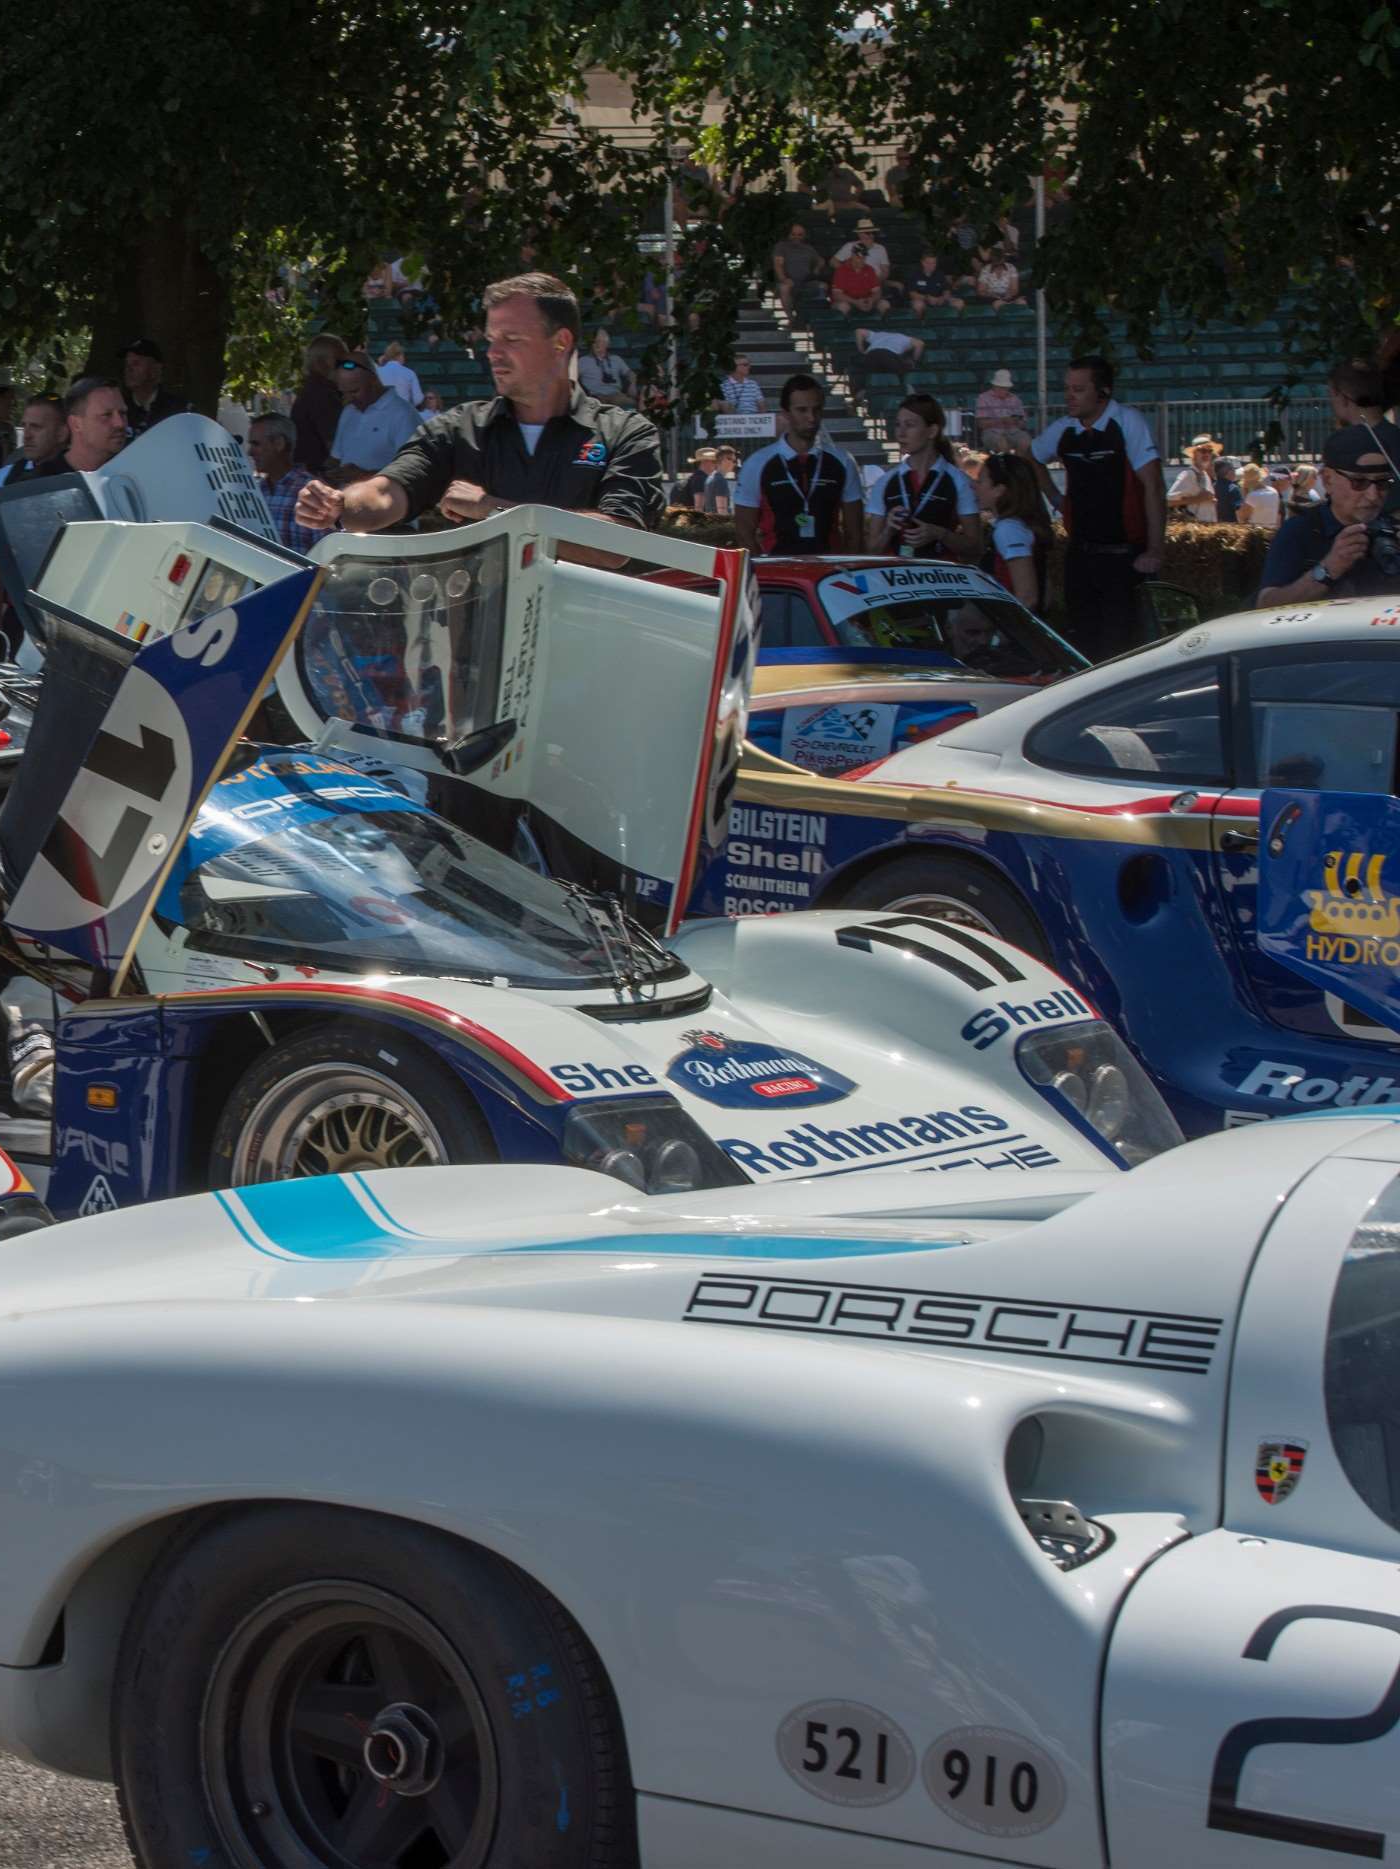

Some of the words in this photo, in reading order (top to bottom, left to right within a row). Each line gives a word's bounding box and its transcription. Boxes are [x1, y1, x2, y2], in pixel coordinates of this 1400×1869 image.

[881, 569, 969, 587] Valvoline
[863, 589, 1012, 607] PORSCHE
[728, 806, 828, 845] BILSTEIN
[726, 841, 822, 875] Shell
[961, 989, 1090, 1051] Shell
[549, 1062, 659, 1092] She
[684, 1056, 819, 1088] Rothmans
[759, 1080, 810, 1095] RACING
[717, 1104, 1010, 1175] Rothmans
[686, 1277, 1222, 1366] PORSCHE
[1206, 1604, 1400, 1860] 2
[802, 1719, 888, 1785] 521
[942, 1748, 1039, 1814] 910
